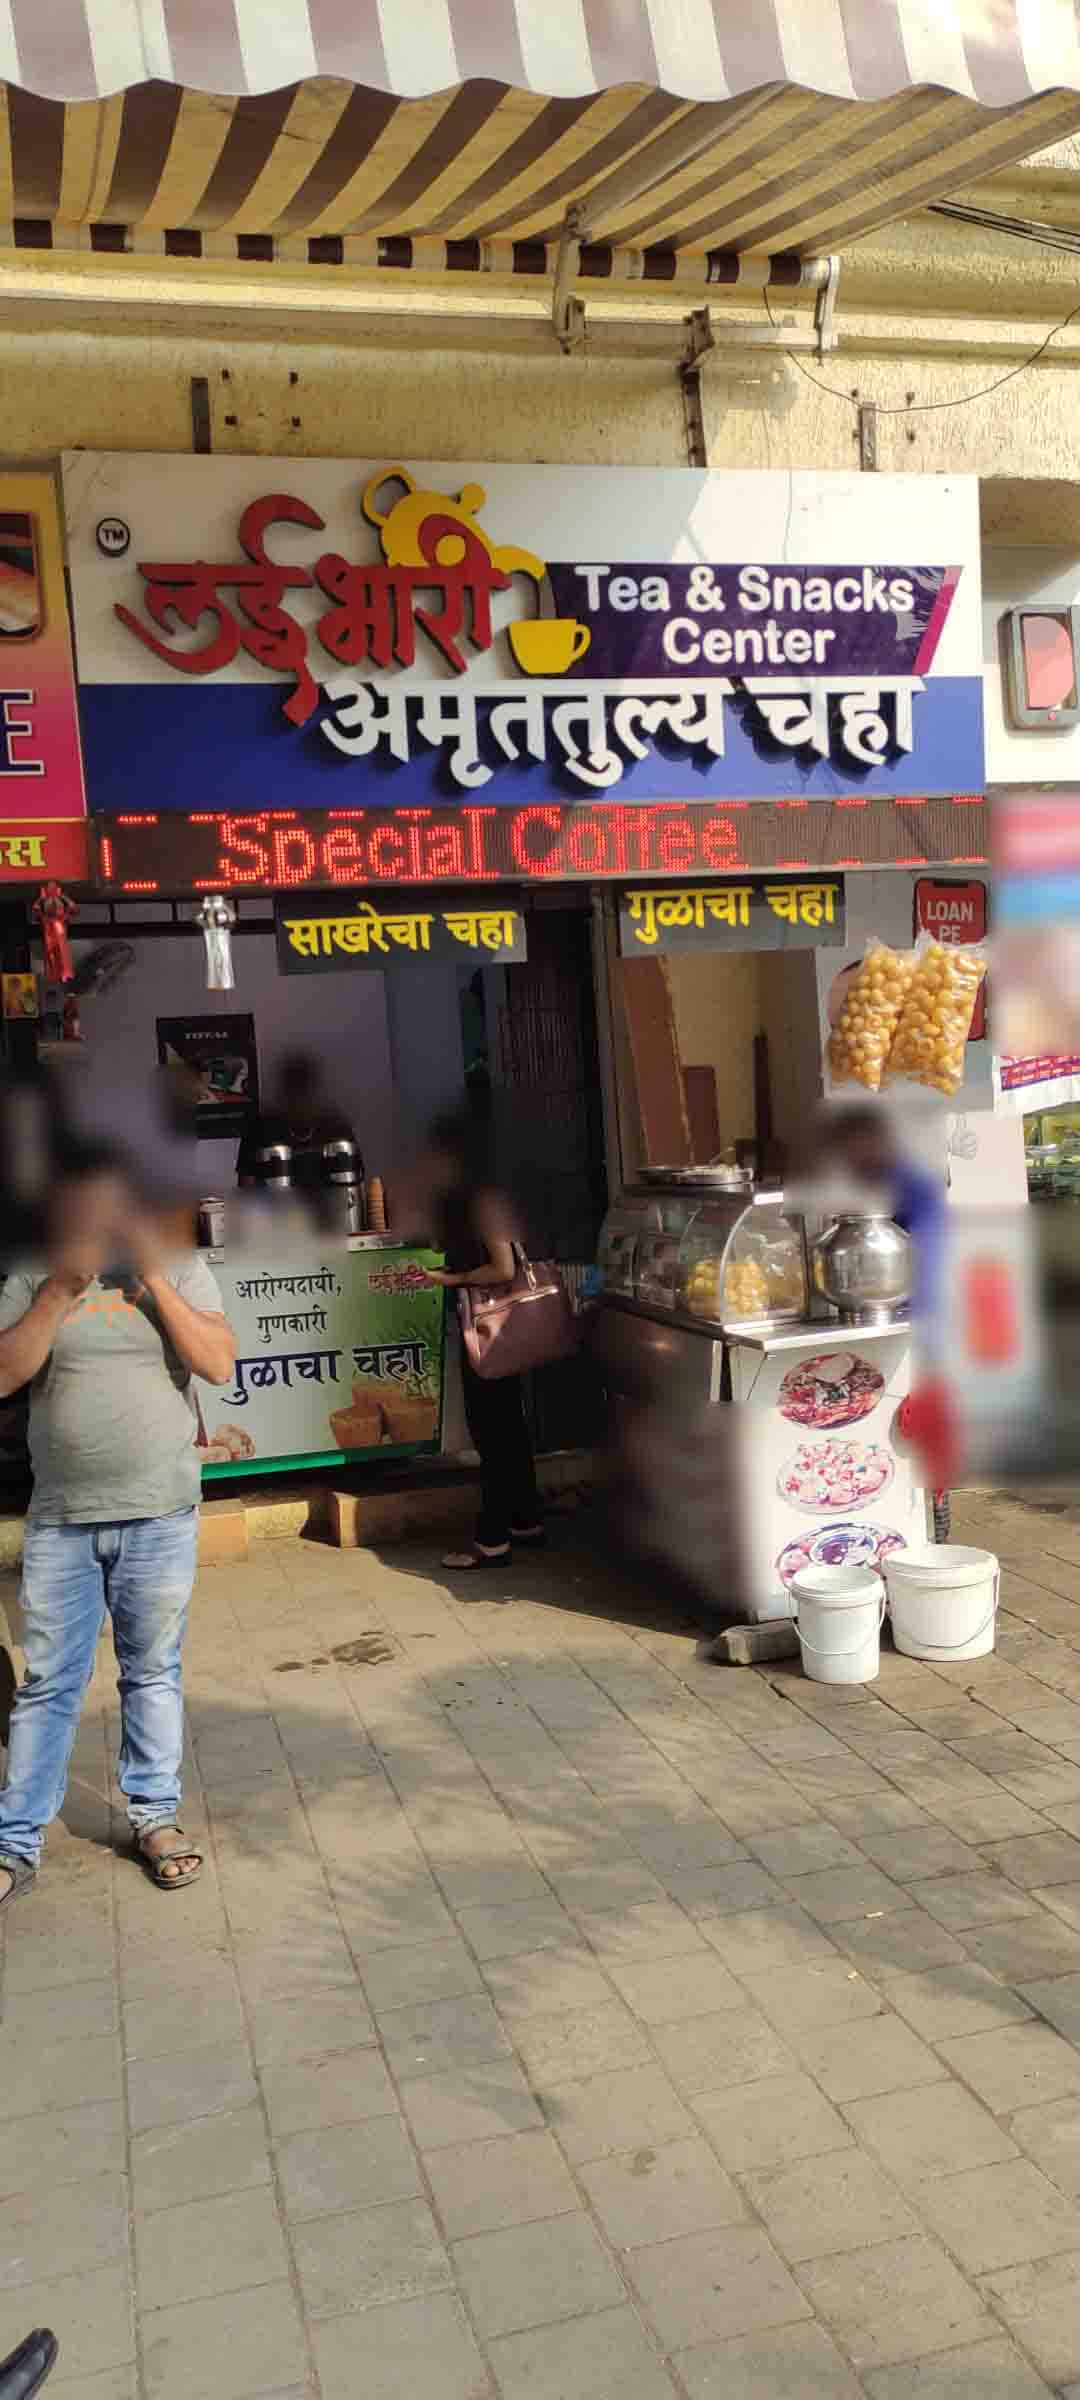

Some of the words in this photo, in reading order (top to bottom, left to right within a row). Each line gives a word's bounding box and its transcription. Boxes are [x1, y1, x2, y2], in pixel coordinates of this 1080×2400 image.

[102, 528, 125, 543] TM
[312, 514, 512, 675] भारी
[575, 565, 671, 612] Tea
[685, 565, 726, 612] &
[738, 565, 914, 613] Snacks
[662, 617, 836, 665] Center
[319, 676, 734, 788] अमृततुल्य
[742, 676, 926, 766] चहा
[219, 810, 501, 883] Special
[511, 805, 738, 876] Coffee
[283, 902, 433, 957] साखरेचा
[443, 911, 517, 950] चहा
[625, 886, 753, 944] गुळाचा
[765, 884, 838, 927] चहा
[927, 900, 974, 921] LOAN
[256, 1304, 328, 1343] गुणकारी
[352, 1342, 427, 1381] चहा
